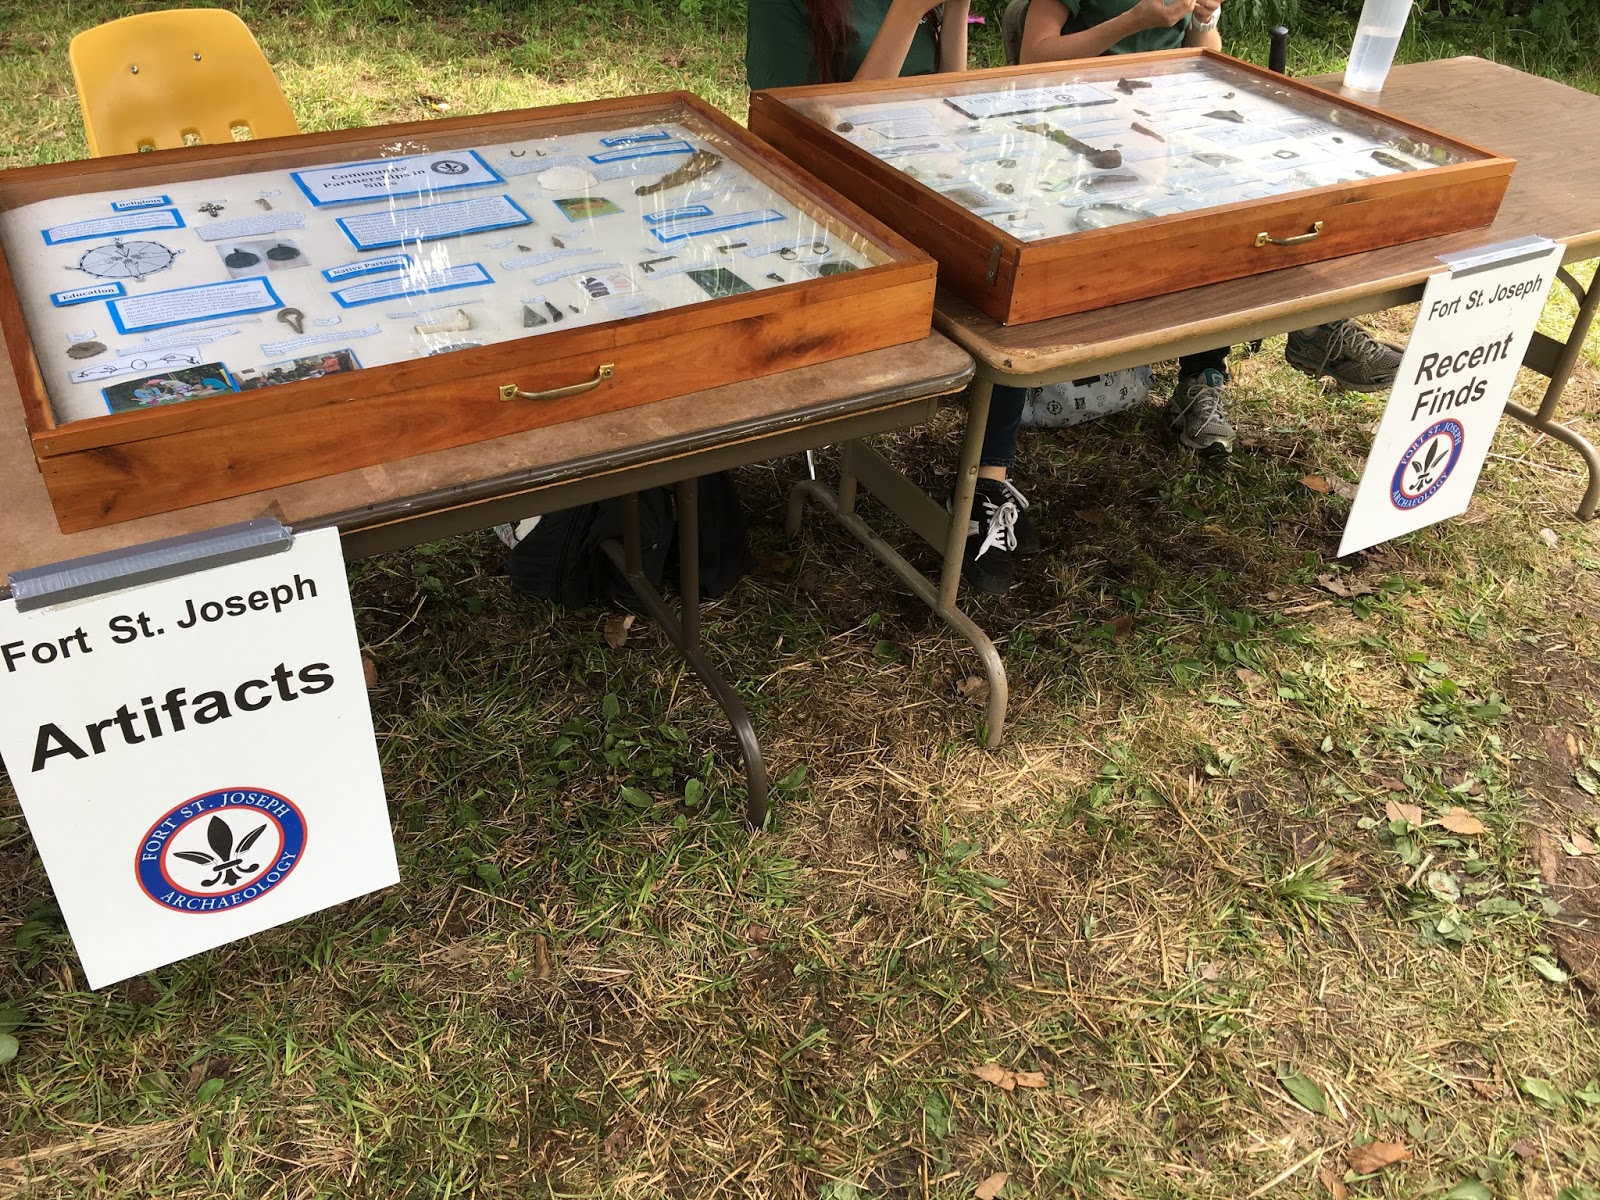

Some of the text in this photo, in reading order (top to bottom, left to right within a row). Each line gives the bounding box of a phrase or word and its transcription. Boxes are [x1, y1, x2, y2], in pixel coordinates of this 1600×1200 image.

[323, 172, 410, 188] Partnerships
[331, 166, 407, 179] Community
[333, 266, 362, 275] Native
[62, 288, 115, 300] Education
[1428, 274, 1543, 321] Fort St. Joseph
[1414, 331, 1514, 385] Recent
[1410, 376, 1488, 421] Finds
[1401, 422, 1462, 465] FORT ST. JOSEPH
[1392, 472, 1447, 508] ARCHAEOLOGY
[1, 574, 318, 672] Fort St. Joseph
[31, 662, 335, 773] Artifacts
[142, 792, 291, 862] FORT ST. JOSEPH
[160, 851, 297, 910] ARCHAEOLOGY
